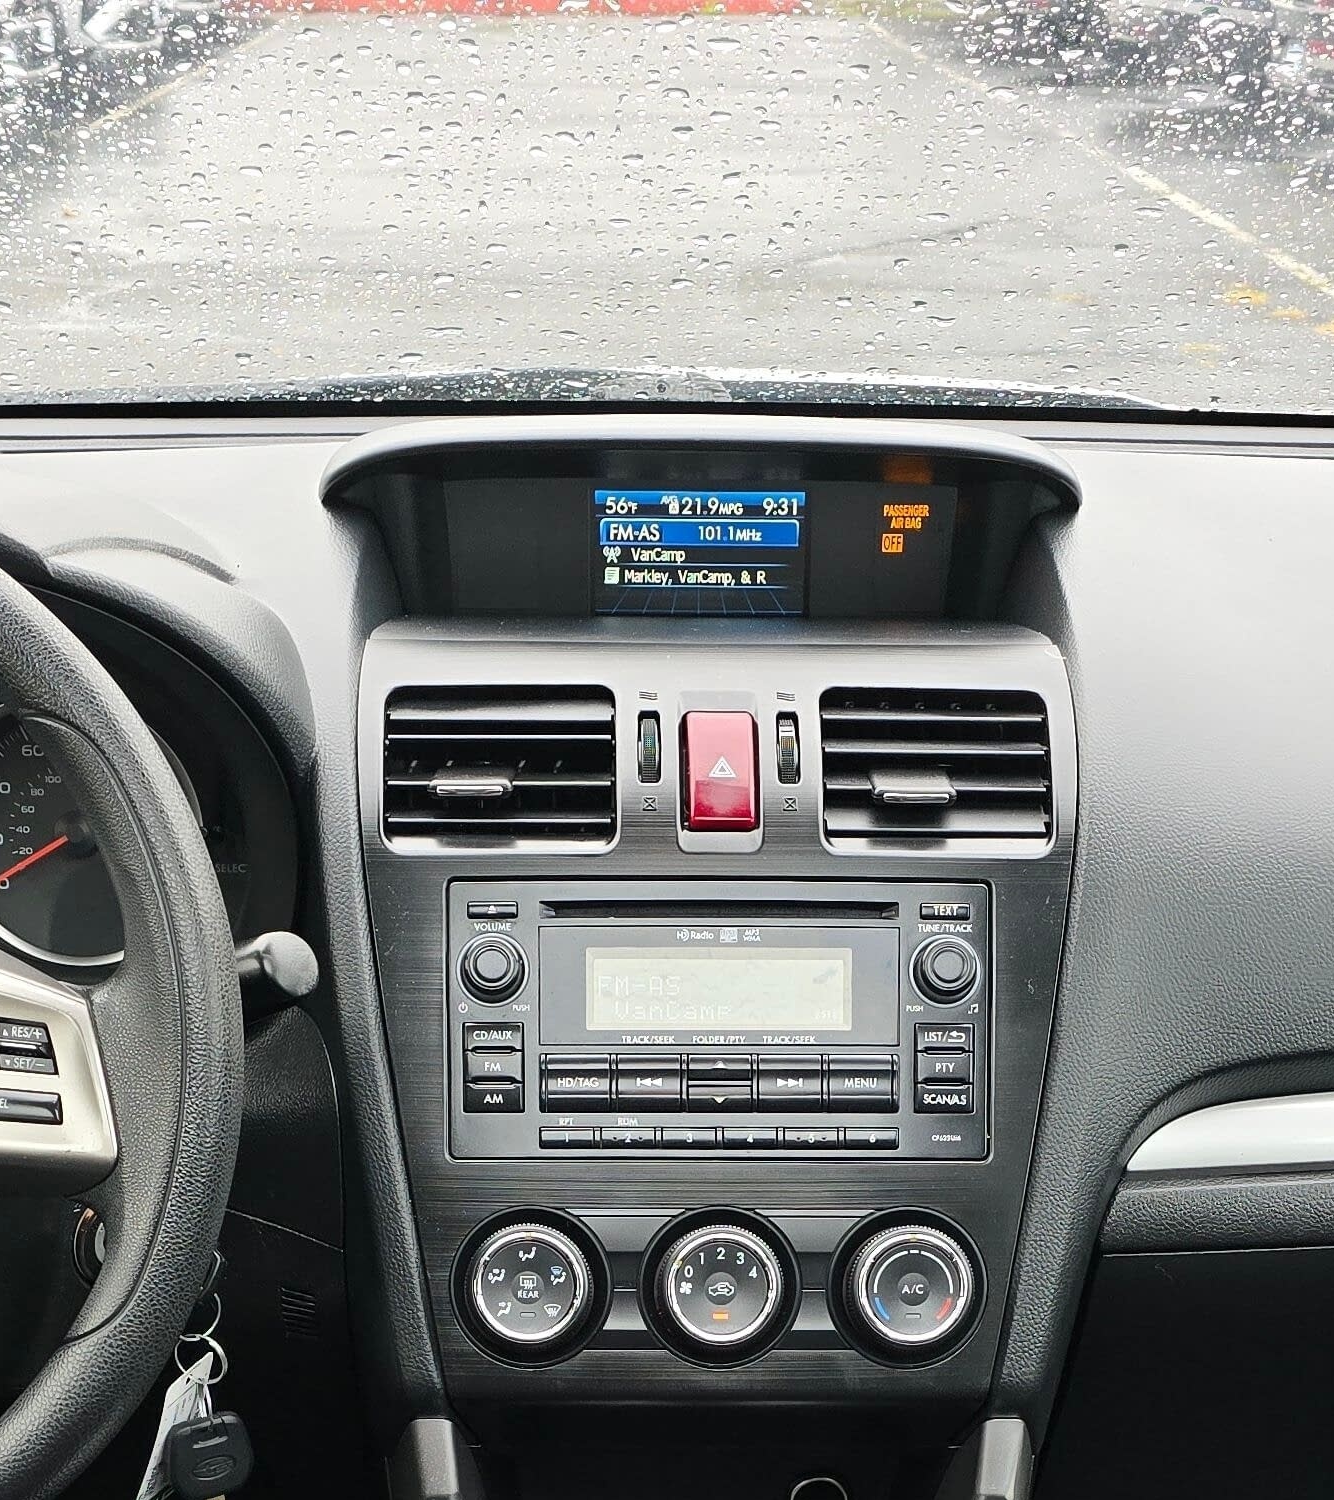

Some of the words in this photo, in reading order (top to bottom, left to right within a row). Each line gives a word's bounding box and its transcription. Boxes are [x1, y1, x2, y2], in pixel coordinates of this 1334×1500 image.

[762, 497, 798, 516] 9:31
[883, 504, 930, 517] PASSENGER
[609, 524, 660, 541] FM-AS
[883, 535, 902, 551] OFF
[630, 548, 686, 564] VanCamp
[624, 569, 673, 587] Markley,
[678, 569, 736, 587] VanCamp,
[740, 571, 752, 585] &
[756, 571, 767, 585] R
[44, 775, 62, 784] 100
[30, 788, 45, 797] 80
[20, 805, 35, 814] 60
[15, 825, 31, 834] 40
[18, 847, 34, 855] 20
[933, 905, 959, 916] TEXT
[473, 922, 512, 932] VOLUME
[917, 924, 973, 933] TUNE/TRACK
[690, 930, 715, 940] Radio
[512, 1004, 531, 1012] PUSH
[905, 1005, 924, 1013] PUSH
[472, 1030, 513, 1041] CD/AUX
[621, 1035, 676, 1045] TRACK/SEEK
[692, 1035, 747, 1045] FOLDER/PTY
[762, 1036, 817, 1045] TRACK/SEEK
[484, 1062, 502, 1072] FM
[935, 1062, 955, 1074] PTY
[557, 1077, 600, 1088] HD/TAG
[844, 1077, 878, 1089] MENU
[483, 1094, 504, 1104] AM
[559, 1117, 574, 1126] RPT
[564, 1133, 569, 1143] 1
[624, 1133, 633, 1143] 2
[685, 1133, 693, 1143] 3
[746, 1133, 754, 1143] 4
[807, 1134, 815, 1143] 5
[869, 1134, 876, 1143] 6
[698, 1252, 705, 1265] 1
[716, 1247, 726, 1260] 2
[736, 1251, 745, 1265] 3
[684, 1265, 694, 1278] 0
[748, 1265, 758, 1278] 4
[517, 1290, 539, 1299] REAR
[901, 1284, 924, 1295] A/C
